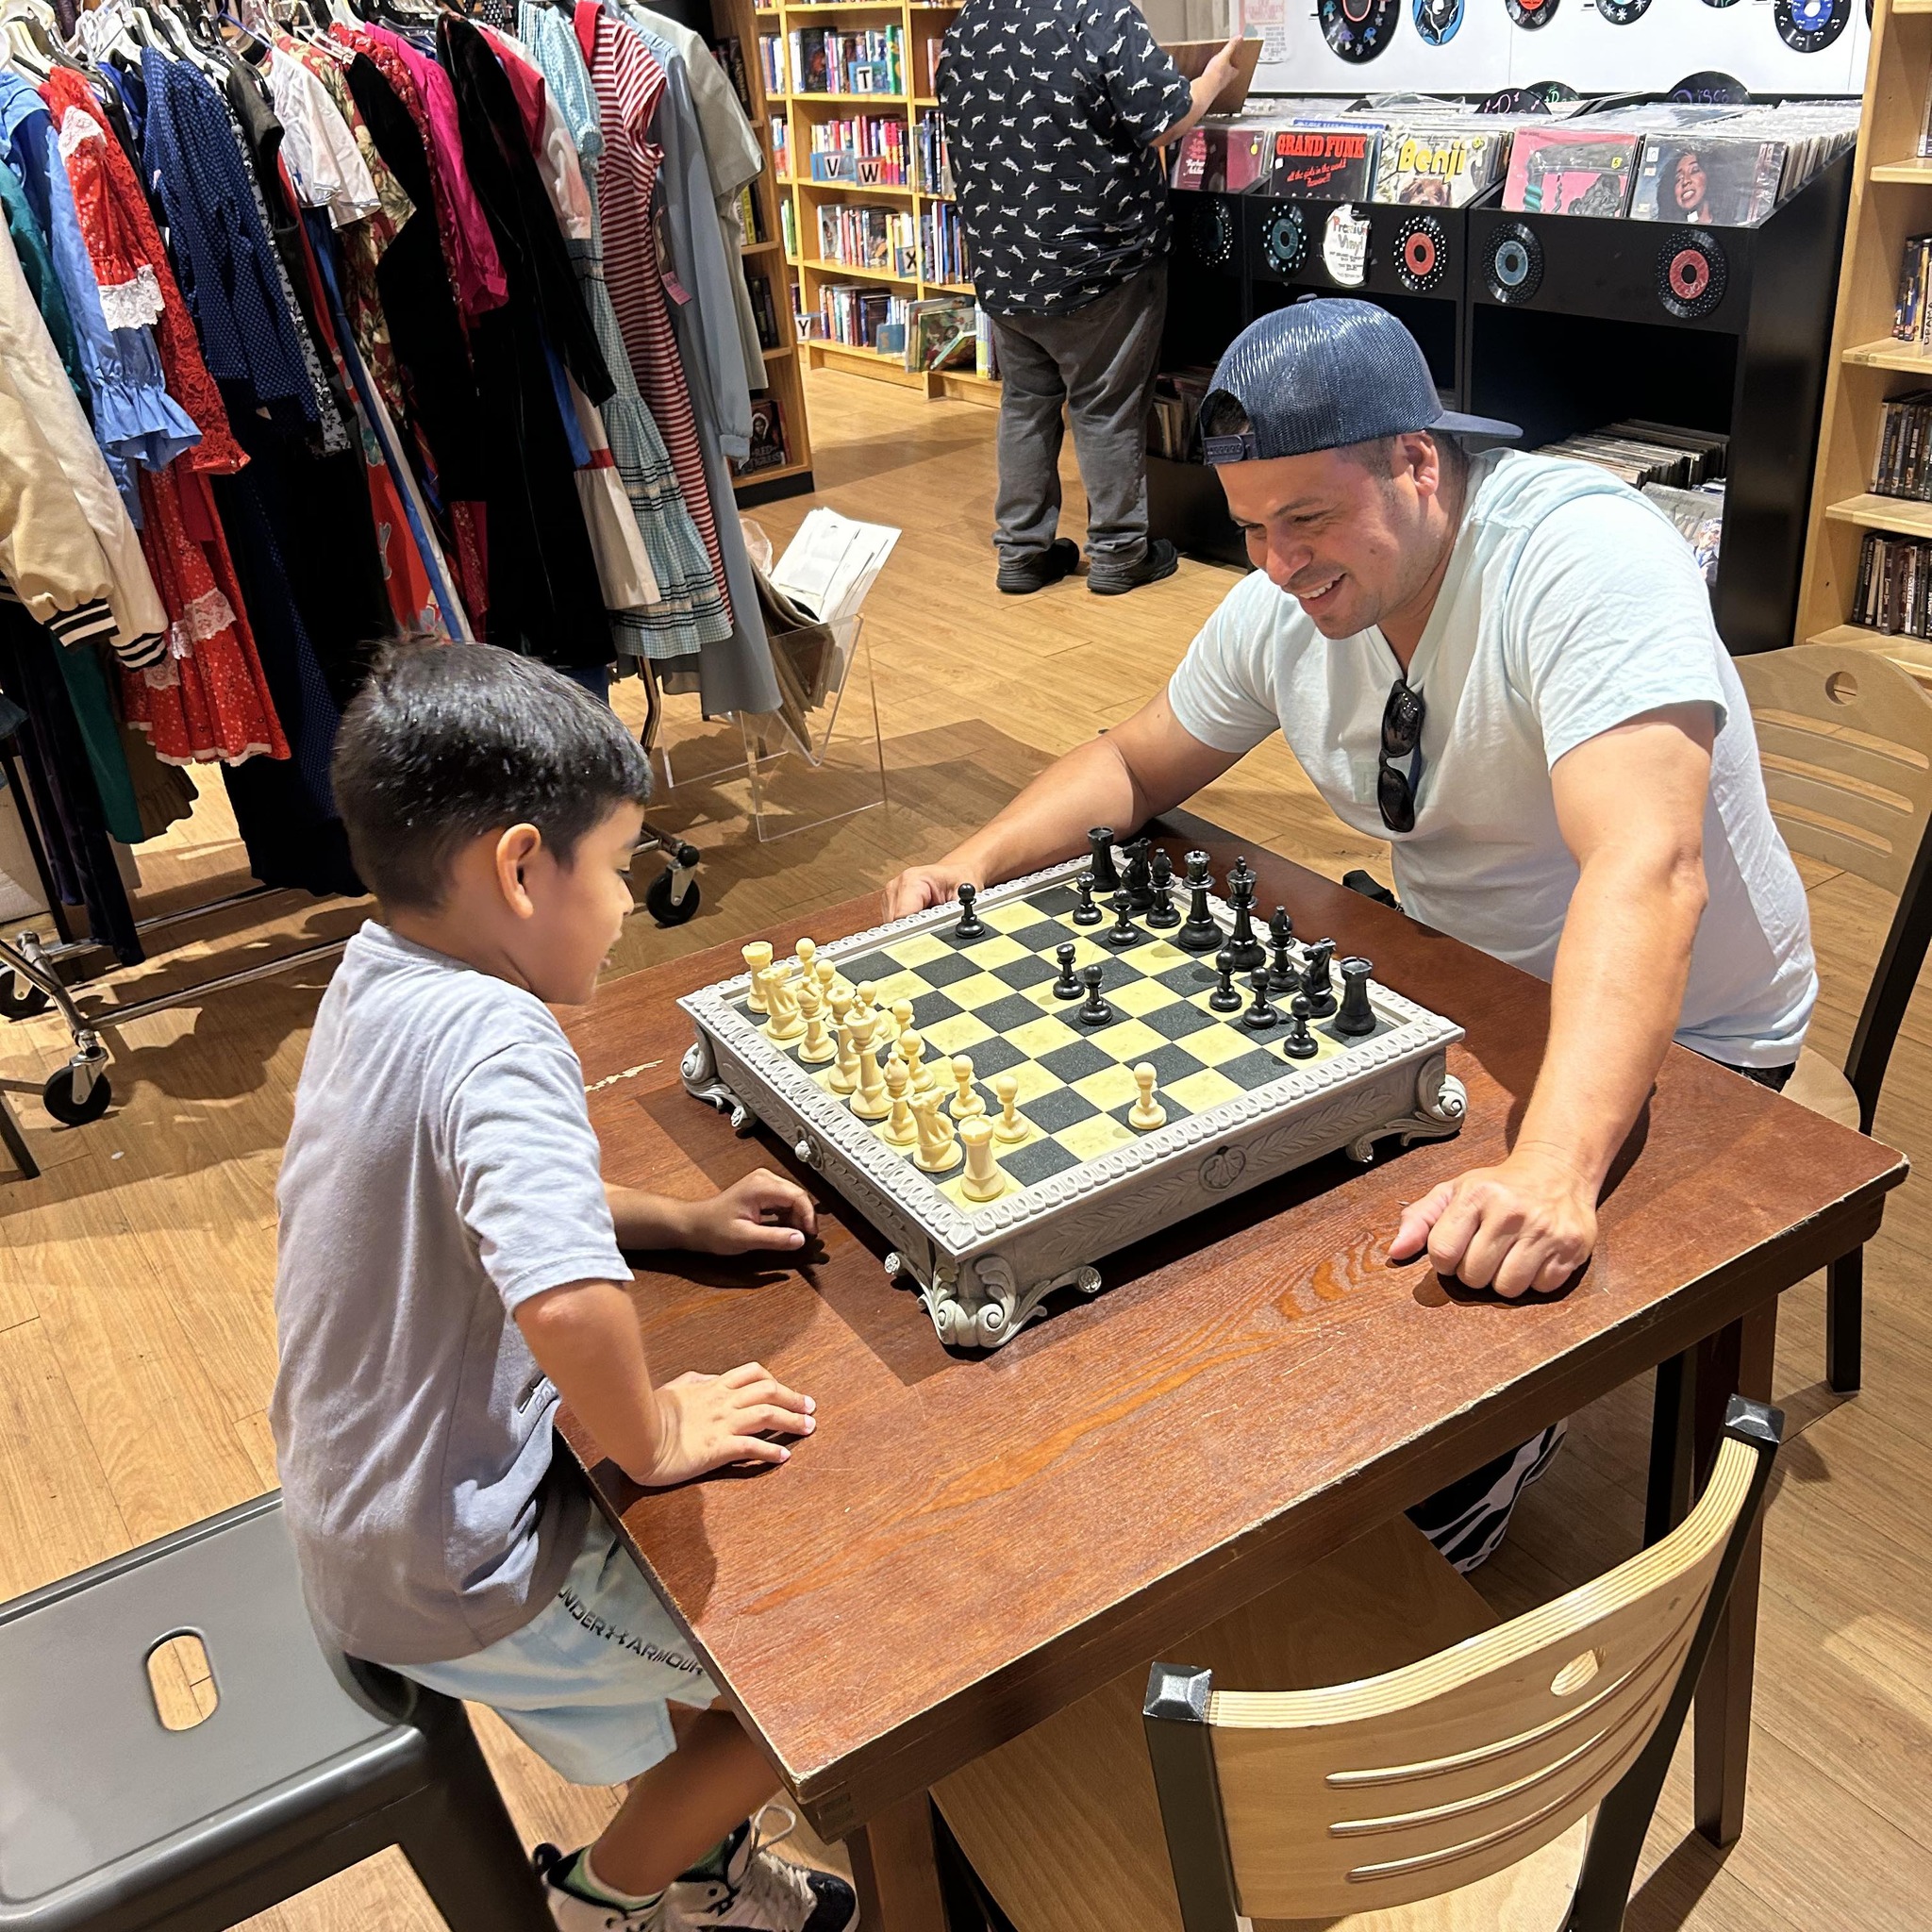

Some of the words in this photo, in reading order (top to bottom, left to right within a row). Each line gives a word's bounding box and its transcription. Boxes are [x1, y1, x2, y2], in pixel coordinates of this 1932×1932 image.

[858, 69, 870, 90] T
[1276, 134, 1324, 158] GRAND
[1324, 135, 1367, 158] FUNK
[826, 157, 840, 177] V
[1396, 138, 1468, 185] Benji
[860, 163, 881, 183] W
[1337, 234, 1364, 257] Vinyl
[907, 251, 917, 270] X
[797, 320, 809, 337] Y
